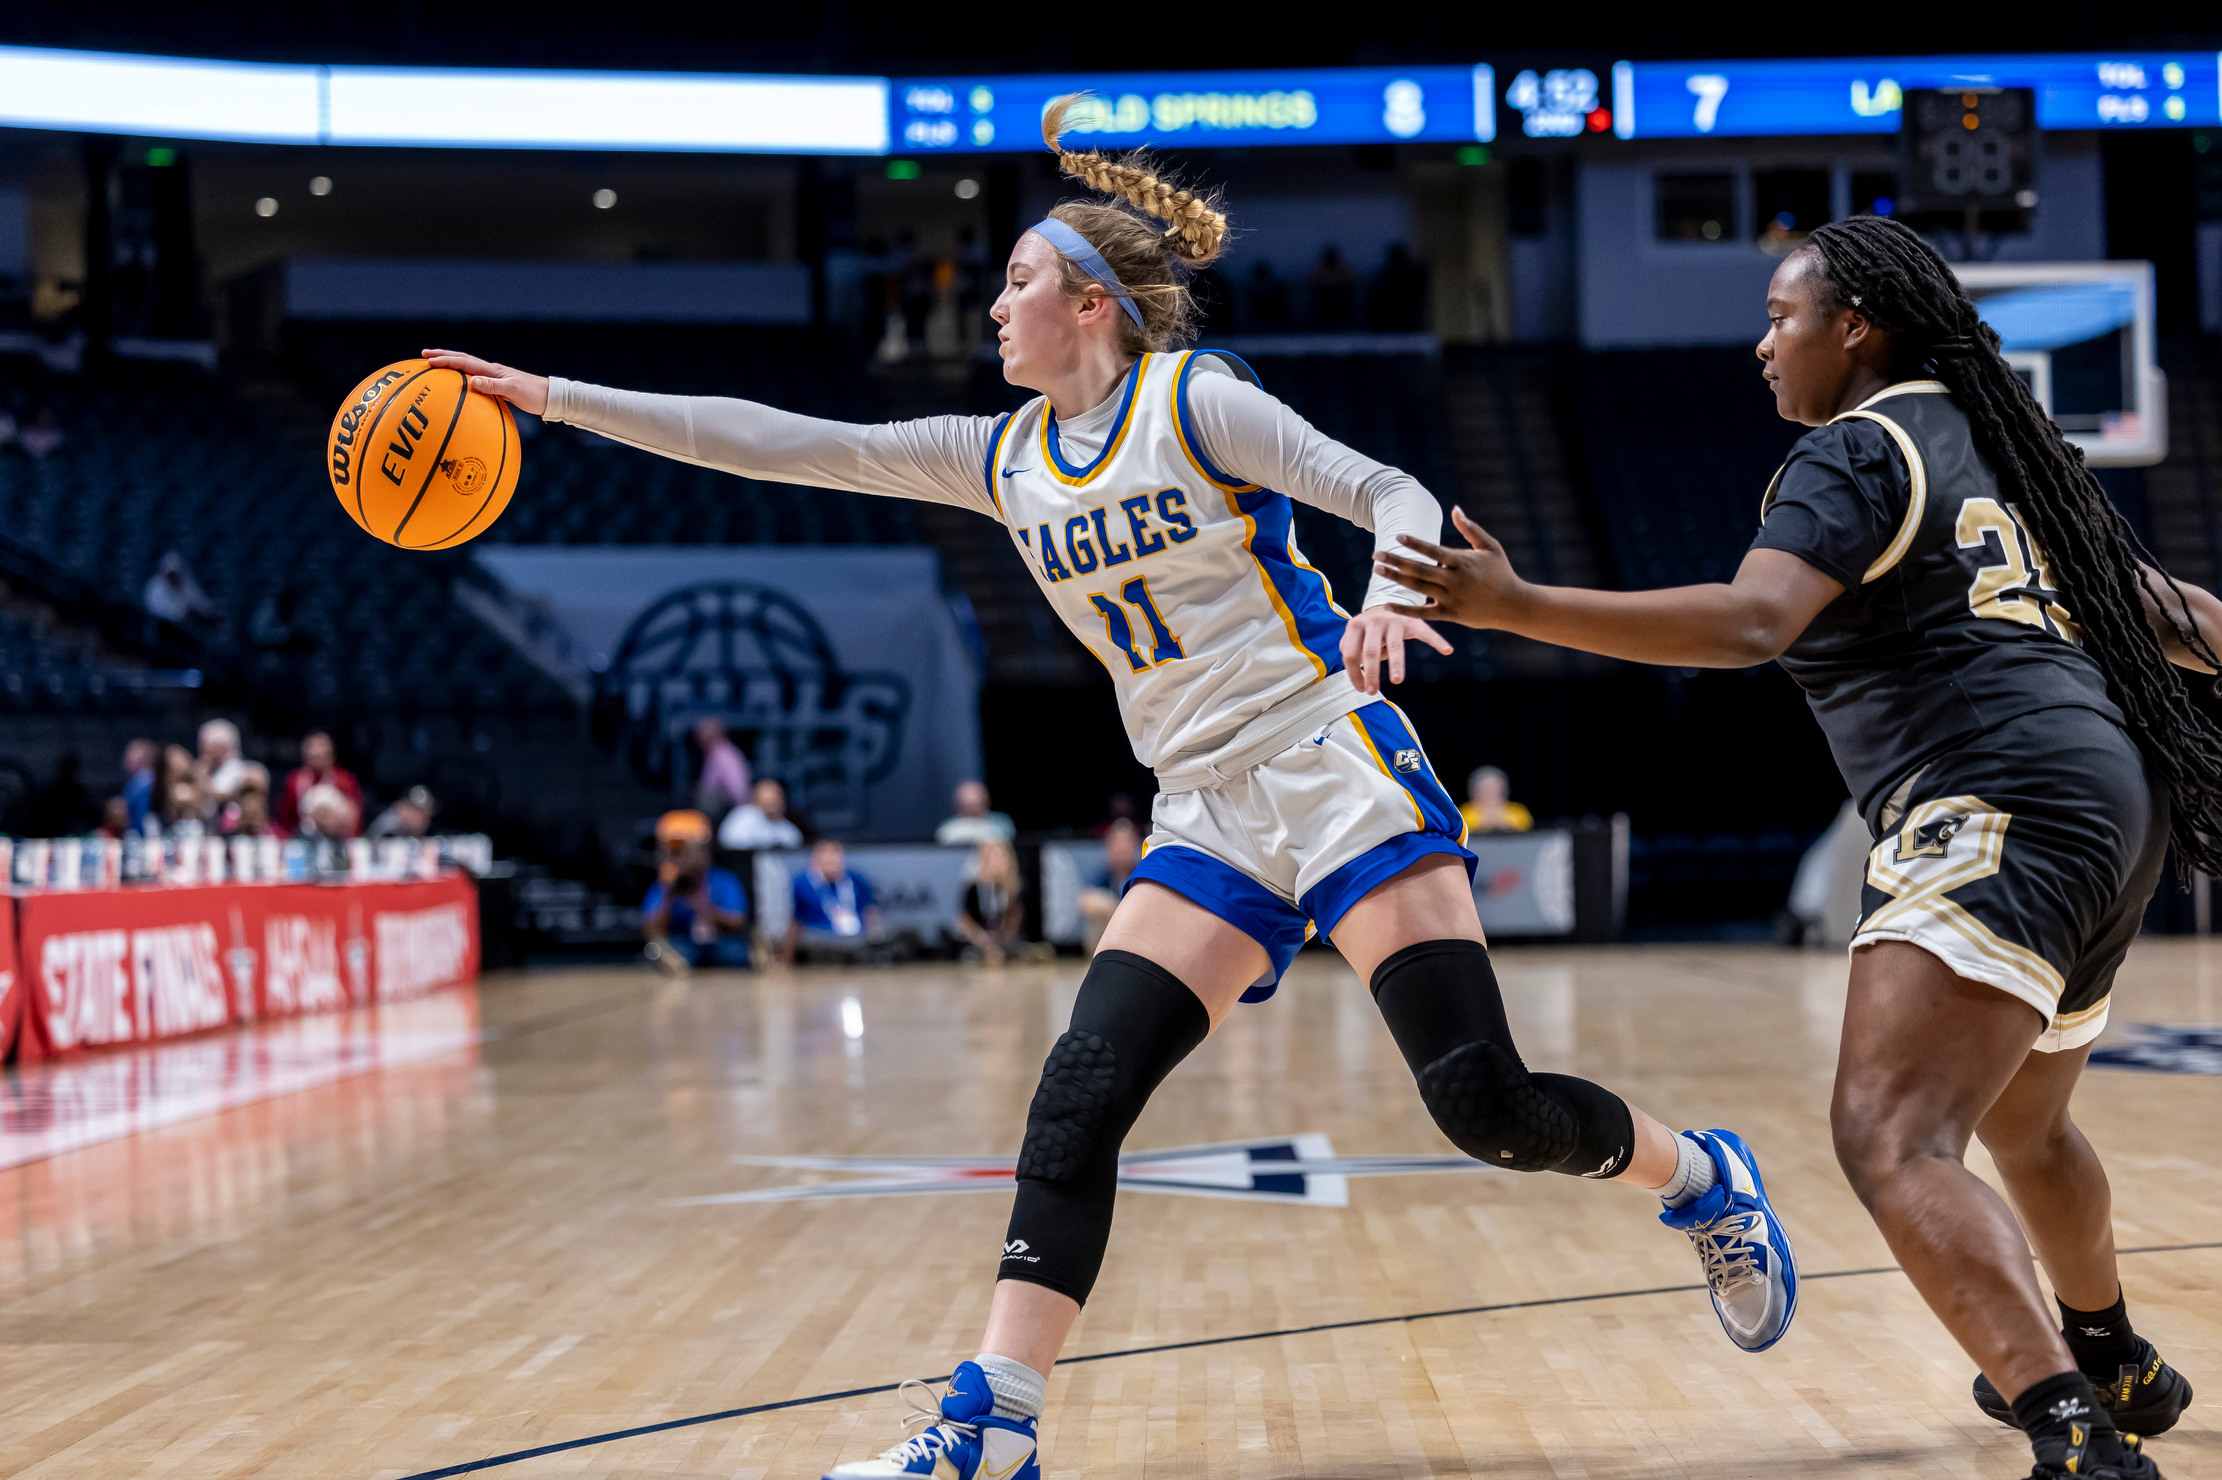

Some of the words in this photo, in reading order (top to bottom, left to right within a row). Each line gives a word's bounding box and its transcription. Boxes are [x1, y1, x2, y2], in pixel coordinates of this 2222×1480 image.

[1686, 74, 1729, 133] 7
[333, 370, 405, 486] Wilson
[415, 384, 432, 407] NXT
[1087, 574, 1187, 675] 11
